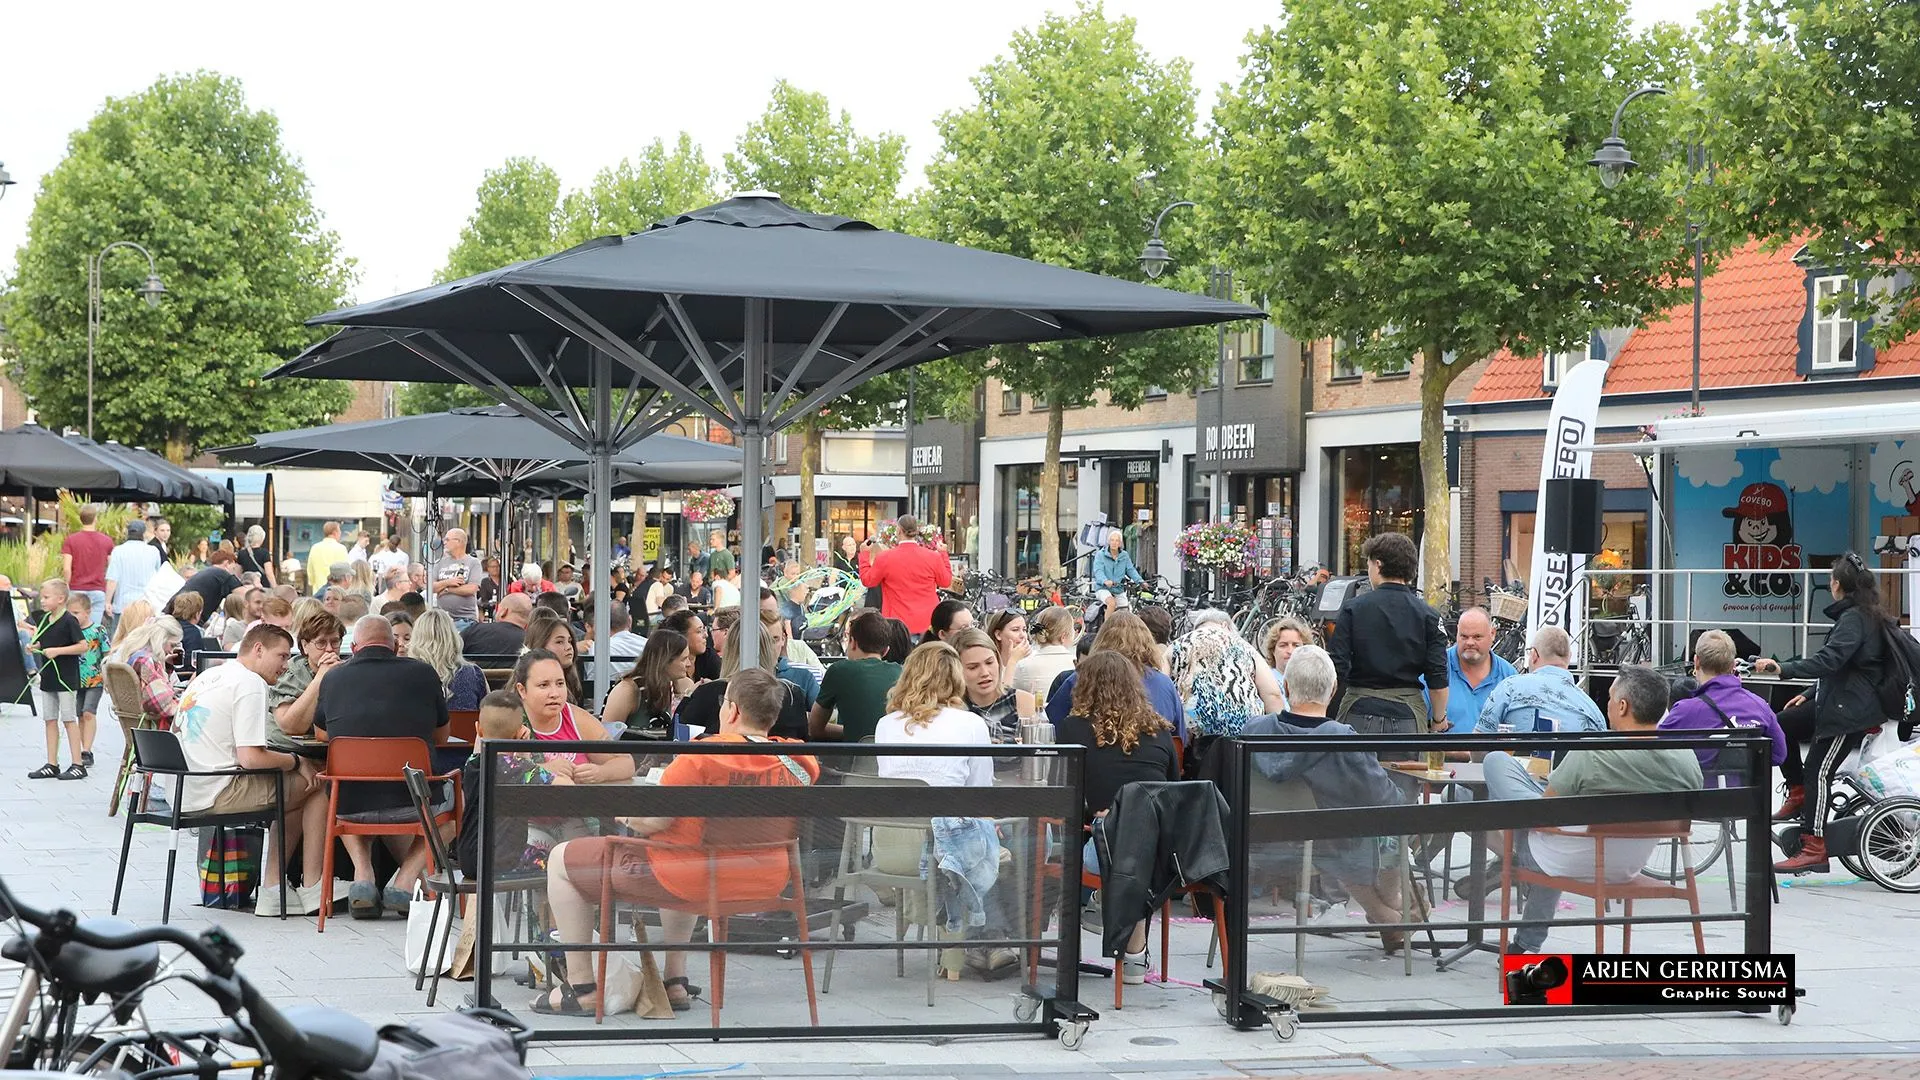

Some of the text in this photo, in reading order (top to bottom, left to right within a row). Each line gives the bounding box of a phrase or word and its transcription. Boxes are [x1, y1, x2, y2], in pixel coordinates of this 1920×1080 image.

[912, 445, 942, 467] REEWEAR
[1557, 428, 1580, 478] EBO
[1740, 496, 1772, 507] COVEBO
[1723, 544, 1802, 570] KIDS
[1544, 558, 1567, 626] OUSE
[1723, 603, 1749, 612] Gewoon
